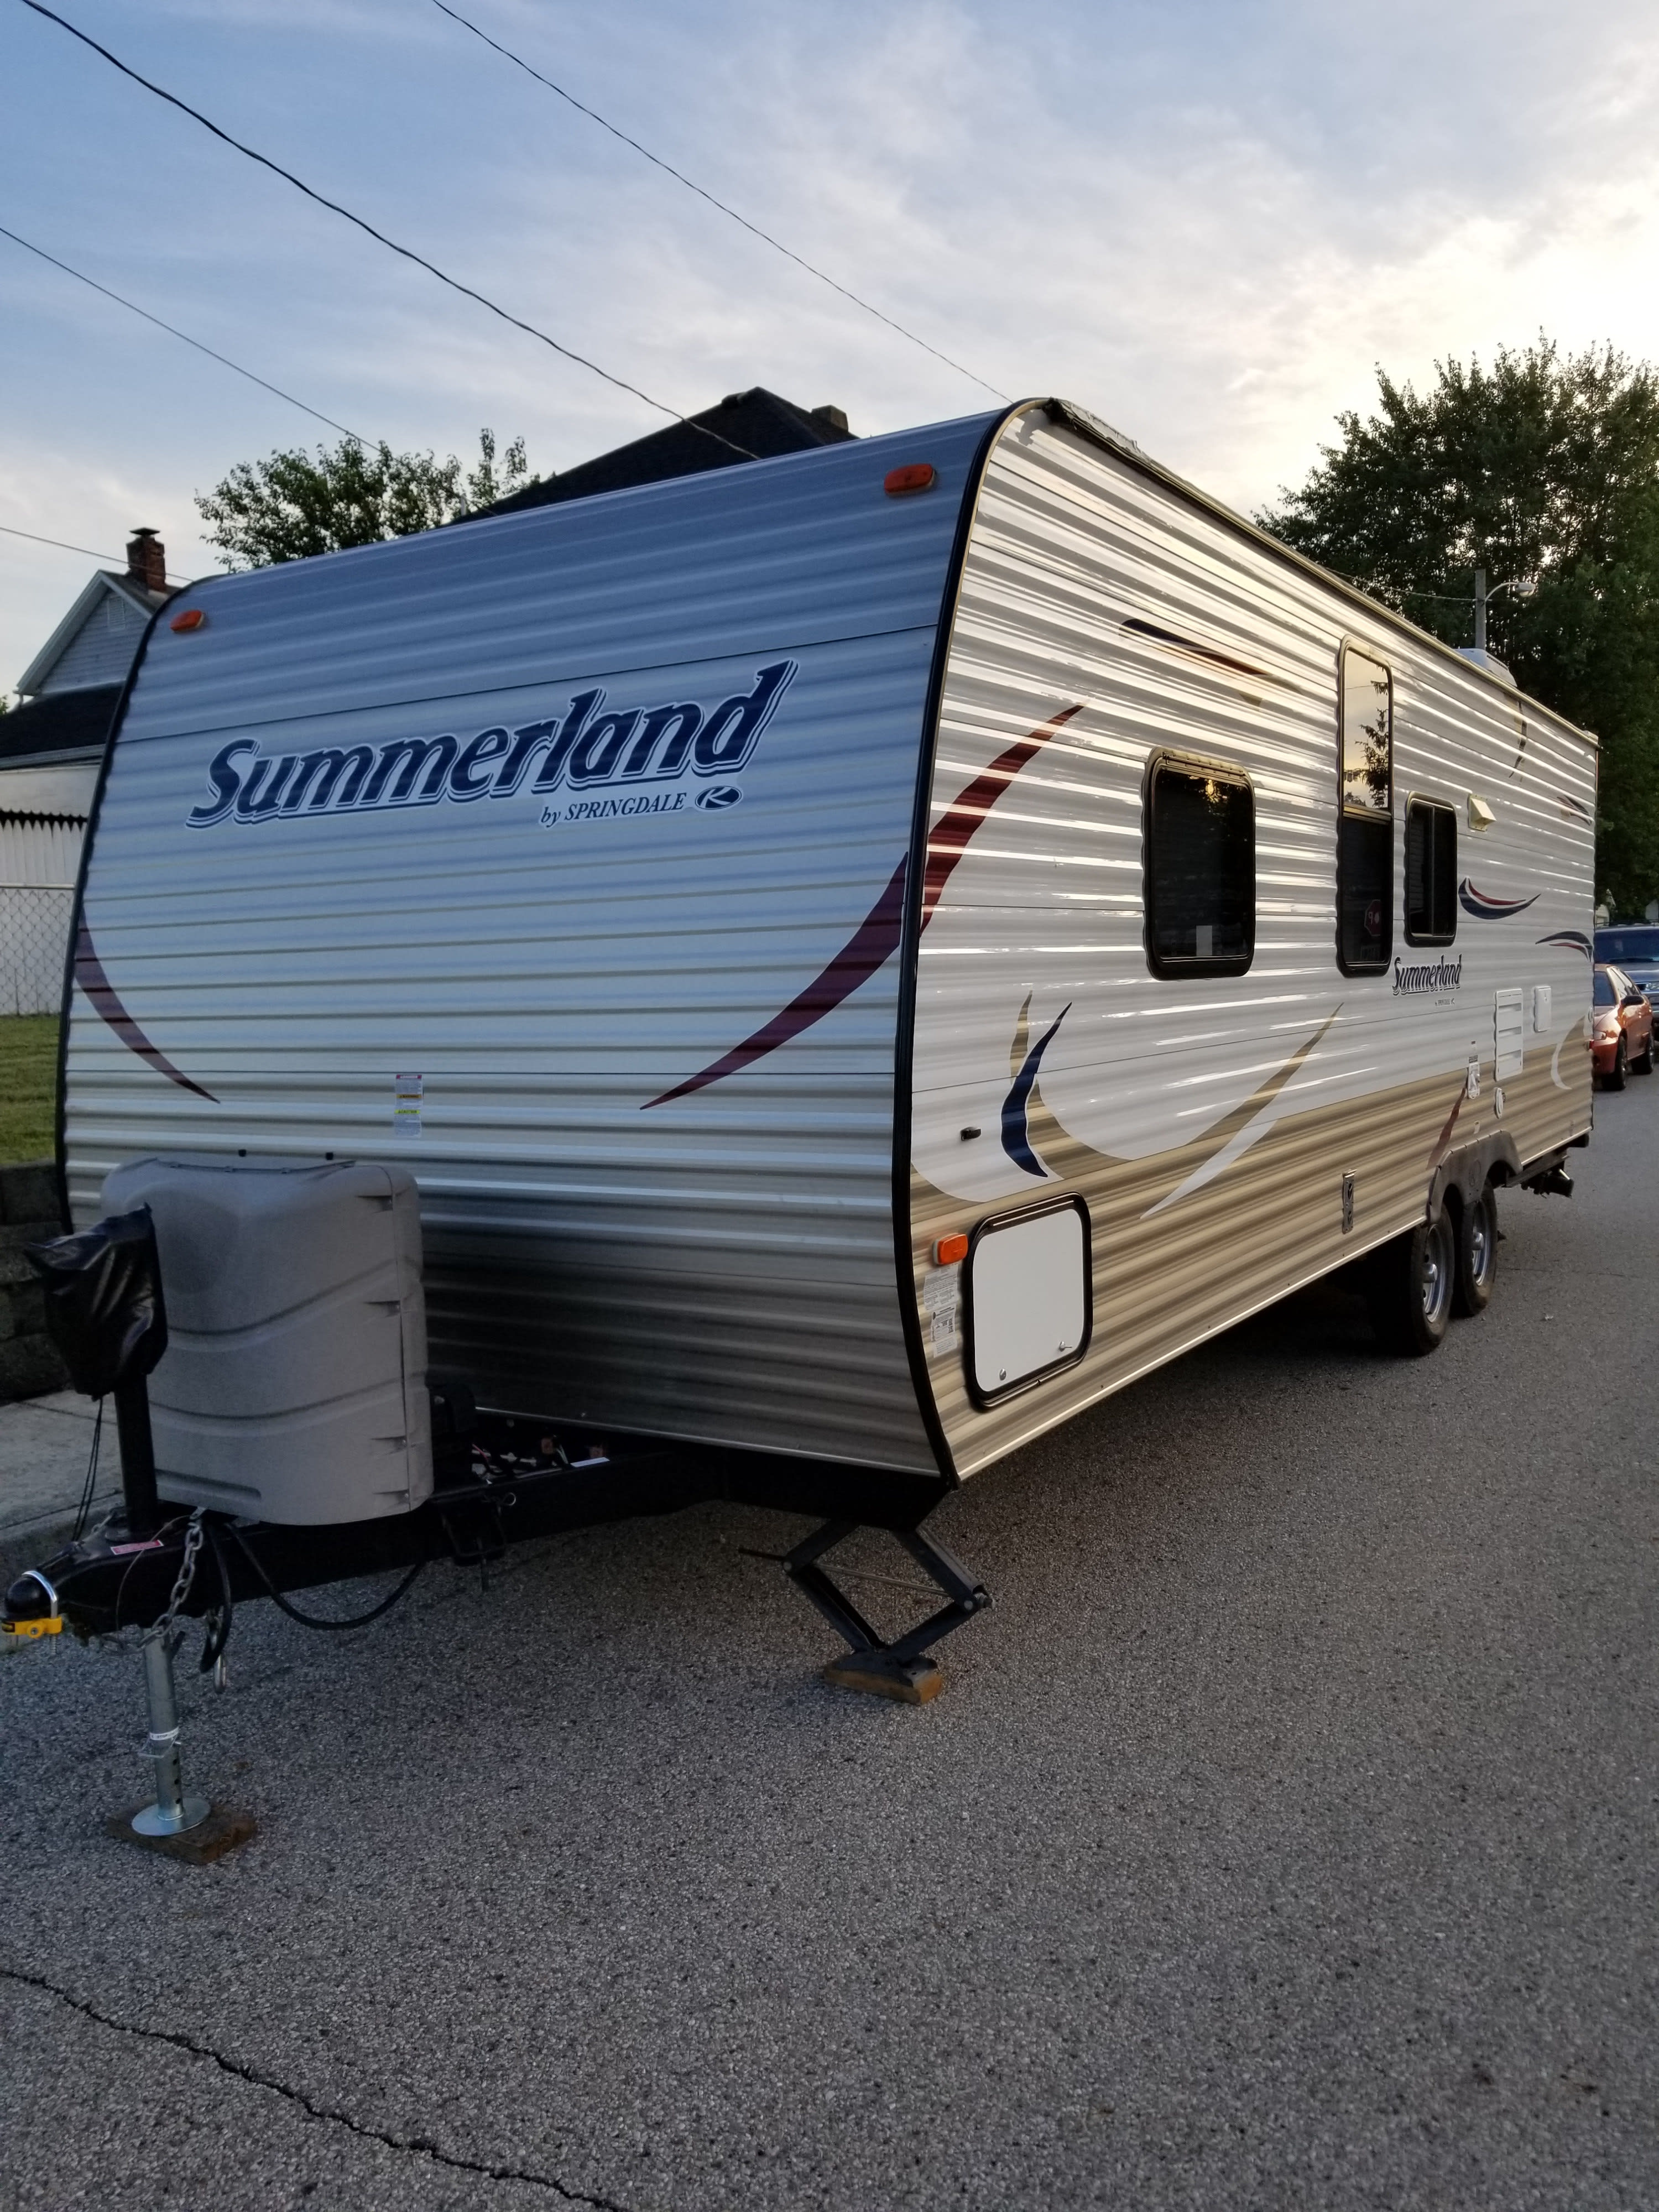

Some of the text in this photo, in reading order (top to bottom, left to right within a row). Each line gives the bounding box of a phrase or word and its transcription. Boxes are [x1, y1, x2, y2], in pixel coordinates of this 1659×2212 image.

[186, 660, 799, 828] Summerland
[541, 807, 560, 828] by
[565, 792, 687, 821] SPRINGDALE
[1392, 953, 1462, 996] Summerland
